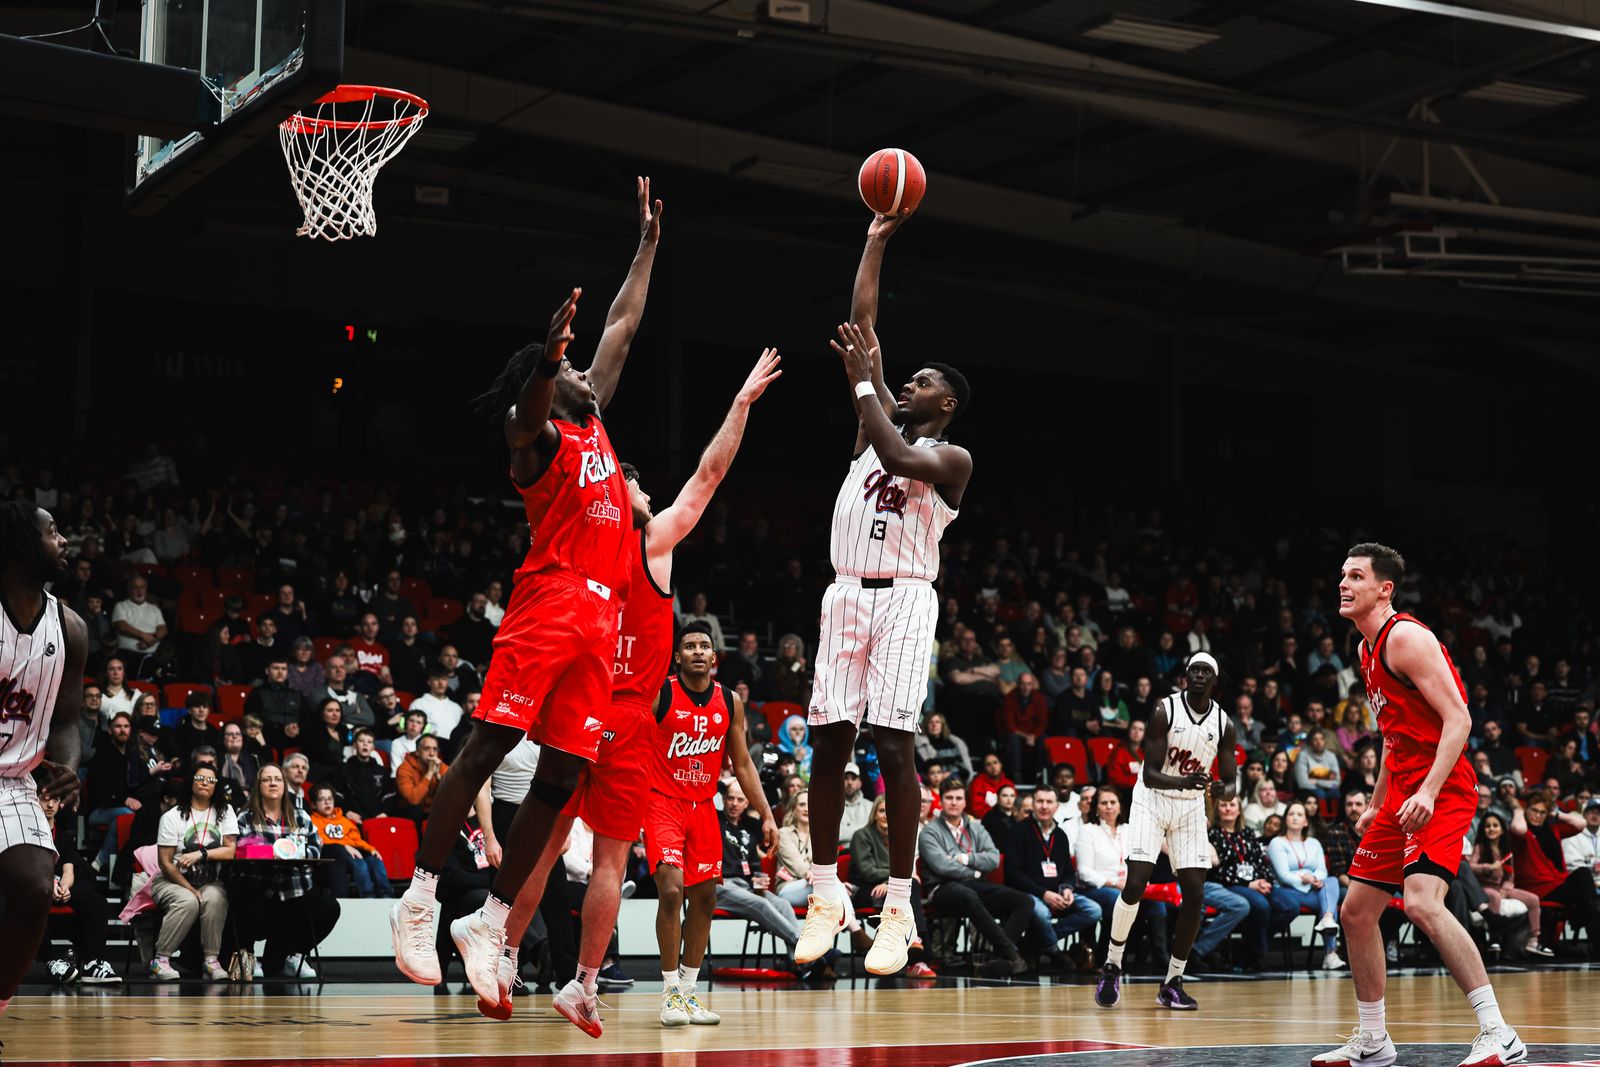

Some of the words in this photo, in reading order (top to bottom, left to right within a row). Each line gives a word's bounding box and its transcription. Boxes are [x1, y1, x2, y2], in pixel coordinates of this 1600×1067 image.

[586, 500, 621, 521] Jeson
[869, 518, 887, 541] 13
[693, 715, 708, 733] 12
[601, 730, 615, 741] ay
[666, 731, 725, 760] Riders
